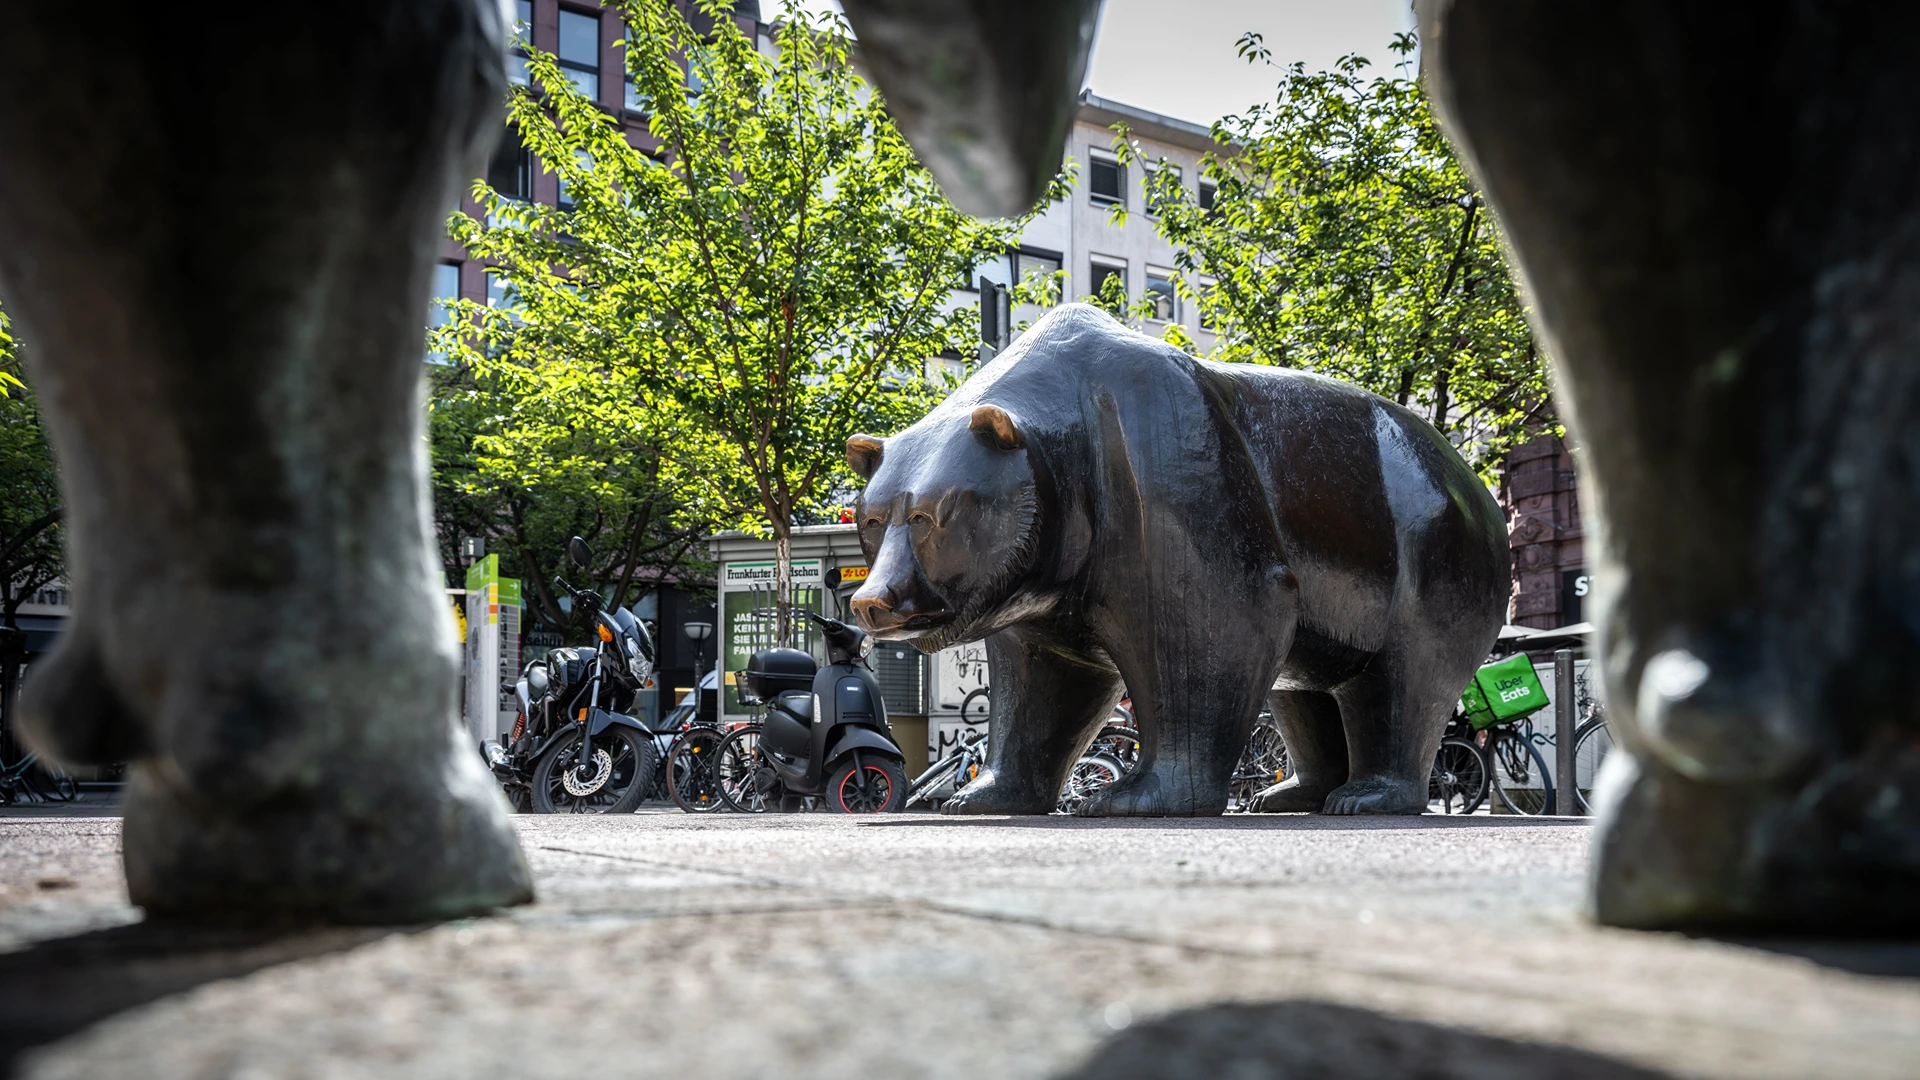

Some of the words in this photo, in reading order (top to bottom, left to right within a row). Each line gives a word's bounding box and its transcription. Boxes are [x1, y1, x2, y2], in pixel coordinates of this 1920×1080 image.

[727, 569, 771, 580] Frankfurter
[773, 566, 819, 578] Rdschau
[733, 634, 751, 644] SIE
[1494, 675, 1524, 692] Uber
[1500, 686, 1531, 703] Eats
